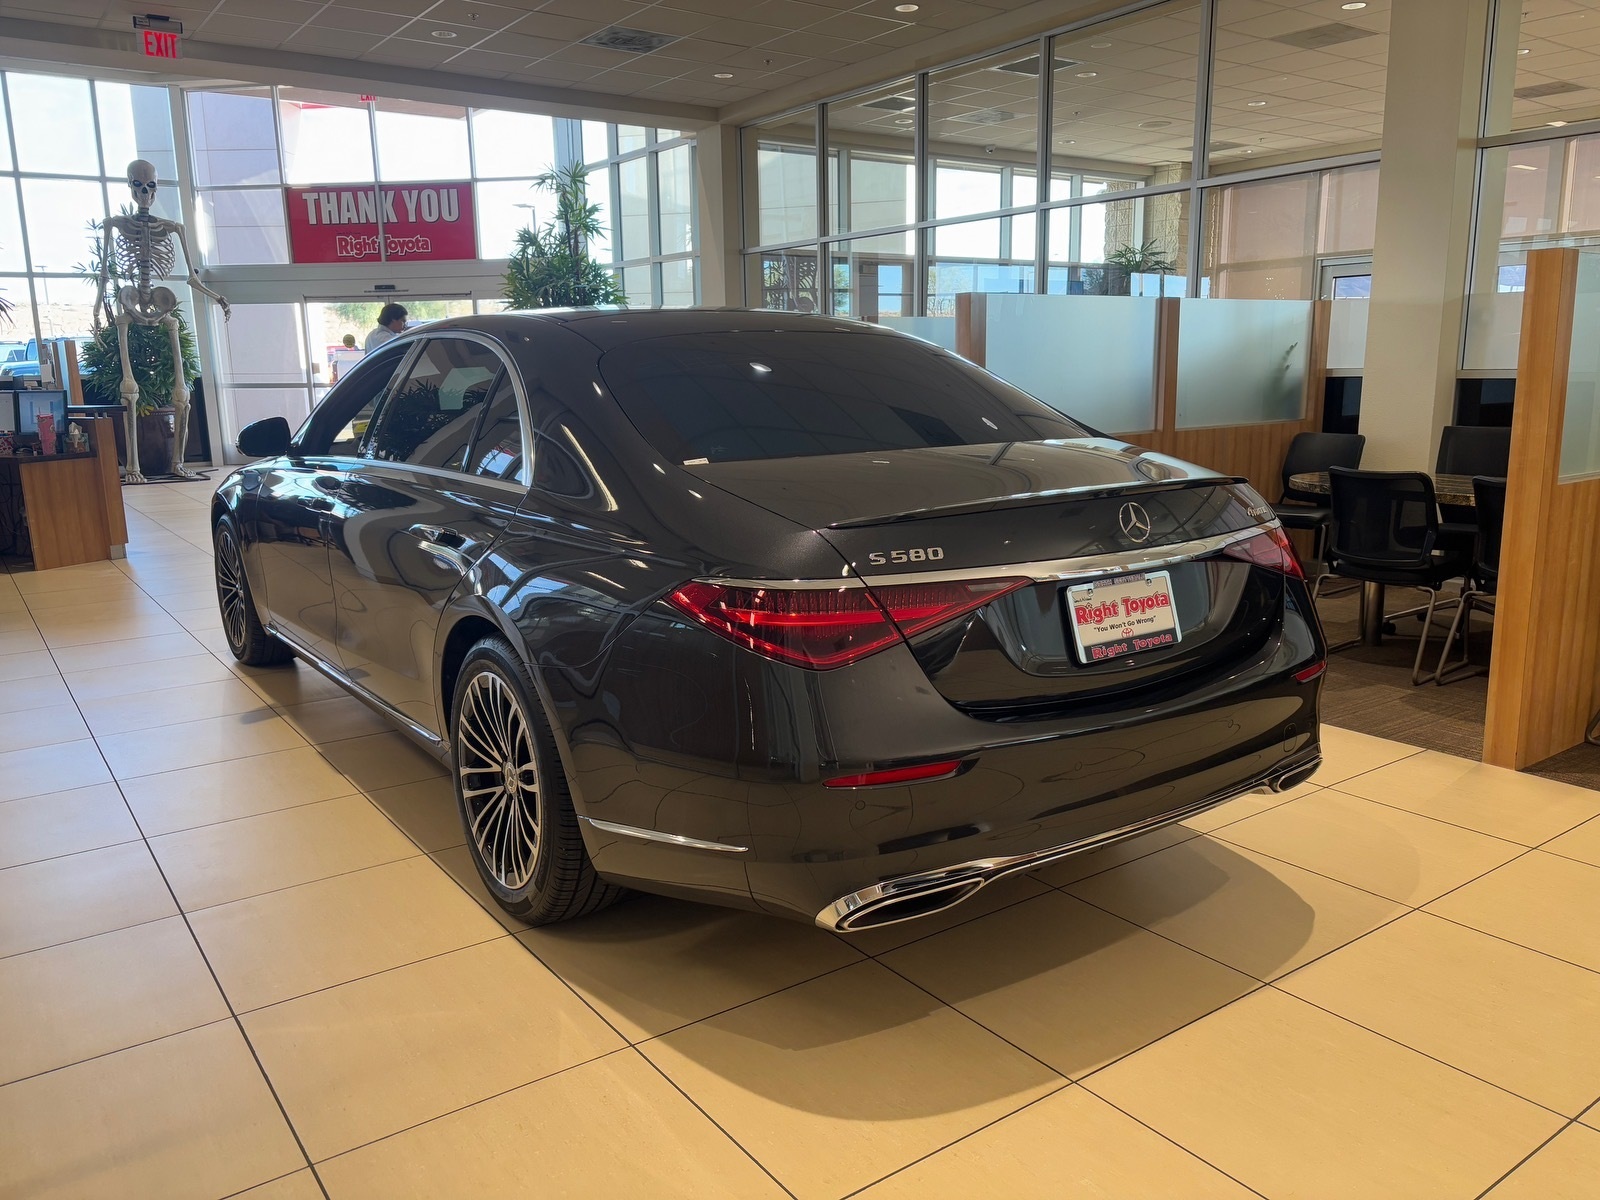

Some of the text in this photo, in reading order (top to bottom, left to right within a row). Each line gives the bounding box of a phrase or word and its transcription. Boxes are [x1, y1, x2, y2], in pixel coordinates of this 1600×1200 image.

[144, 30, 177, 58] EXIT
[302, 189, 459, 224] THANK YOU
[336, 235, 431, 258] Right Toyota
[868, 547, 944, 566] S 580
[1075, 592, 1170, 625] Right Toyota
[1109, 622, 1126, 630] Won't
[1128, 619, 1136, 627] Go
[1092, 643, 1127, 658] Right
[1133, 634, 1172, 650] Toyota
